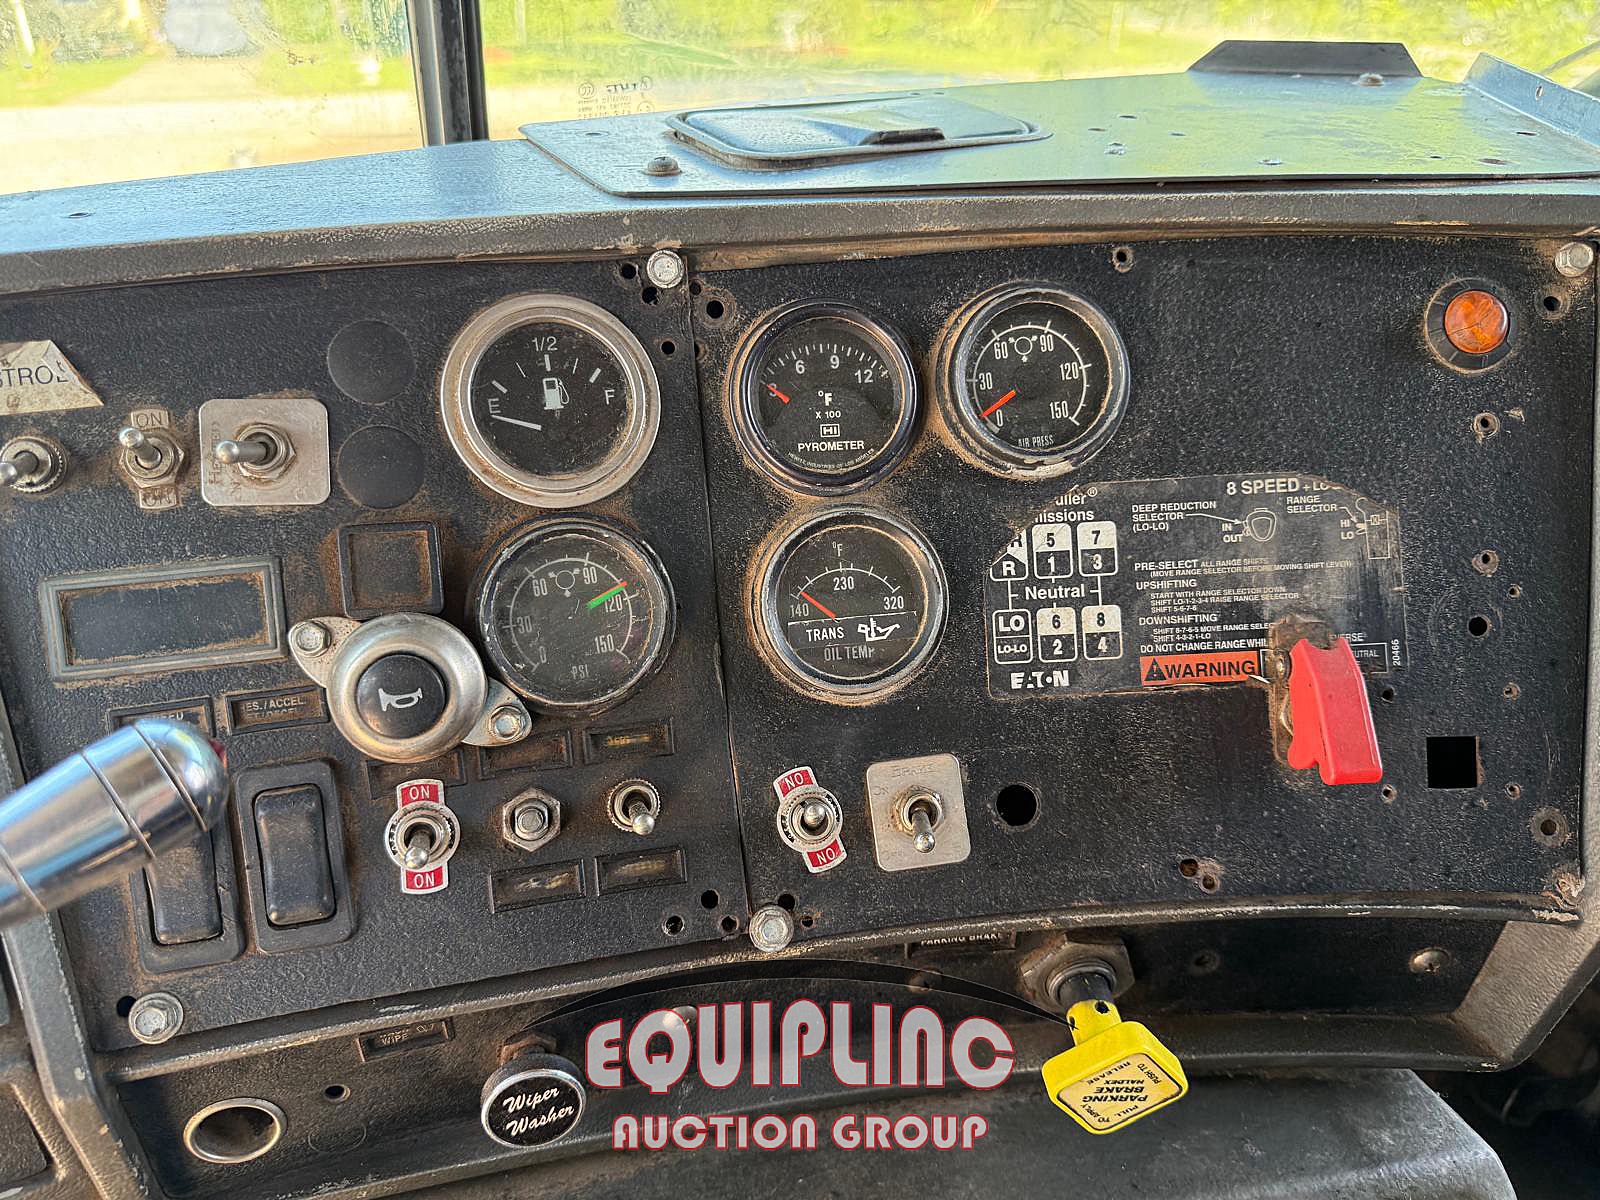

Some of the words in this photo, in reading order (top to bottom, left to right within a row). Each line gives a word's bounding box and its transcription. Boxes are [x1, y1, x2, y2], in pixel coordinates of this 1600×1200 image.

[532, 336, 558, 351] 1/2
[994, 341, 1008, 360] 60
[1040, 334, 1054, 352] 90
[795, 359, 806, 374] 6
[830, 355, 840, 369] 9
[0, 364, 70, 388] TROL
[854, 368, 874, 384] 12
[1060, 362, 1079, 381] 120
[979, 372, 992, 390] 30
[604, 389, 615, 405] F
[488, 398, 501, 414] E
[1050, 401, 1069, 420] 150
[136, 412, 162, 428] ON
[996, 410, 1003, 427] 0
[798, 440, 864, 452] PYROMETER
[1018, 437, 1030, 448] AIR
[1032, 434, 1054, 446] PRESS
[1226, 482, 1237, 496] 8
[1241, 478, 1300, 494] SPEED
[1132, 504, 1158, 512] DEEP
[1160, 501, 1216, 512] REDUCTION
[1286, 495, 1320, 504] RANGE
[1132, 512, 1184, 522] SELECTOR
[1287, 504, 1337, 514] SELECTOR
[1132, 522, 1168, 533] (LO-LO)
[1222, 523, 1232, 531] IN
[1046, 532, 1056, 547] 5
[1092, 530, 1101, 544] 7
[1223, 534, 1243, 542] OUT
[1002, 561, 1016, 576] R
[1048, 555, 1055, 576] 1
[1092, 554, 1103, 570] 3
[1135, 560, 1199, 571] PRE-SELECT
[582, 566, 598, 585] 90
[833, 576, 854, 591] 230
[532, 578, 548, 597] 60
[1025, 584, 1085, 600] Neutral
[1136, 579, 1197, 590] UPSHIFTING
[790, 603, 809, 618] 140
[883, 595, 904, 610] 320
[516, 616, 532, 634] 30
[998, 614, 1025, 632] LO
[1052, 614, 1061, 629] 6
[1097, 612, 1106, 627] 8
[1139, 614, 1218, 626] DOWNSHIFTING
[806, 626, 845, 642] TRANS
[594, 634, 615, 654] 150
[998, 644, 1028, 654] LO-LO
[1052, 638, 1062, 655] 2
[1098, 636, 1108, 652] 4
[1140, 645, 1153, 653] DO
[1156, 644, 1173, 652] NOT
[1175, 641, 1212, 651] CHANGE
[1214, 640, 1246, 649] RANGE
[1247, 638, 1268, 648] WHIL
[539, 646, 547, 664] 0
[824, 647, 842, 662] OIL
[570, 664, 590, 680] PSI
[1165, 660, 1255, 678] WARNING
[409, 785, 430, 800] ON
[414, 872, 434, 888] ON
[502, 1086, 560, 1114] Wiper
[506, 1104, 574, 1136] Washer
